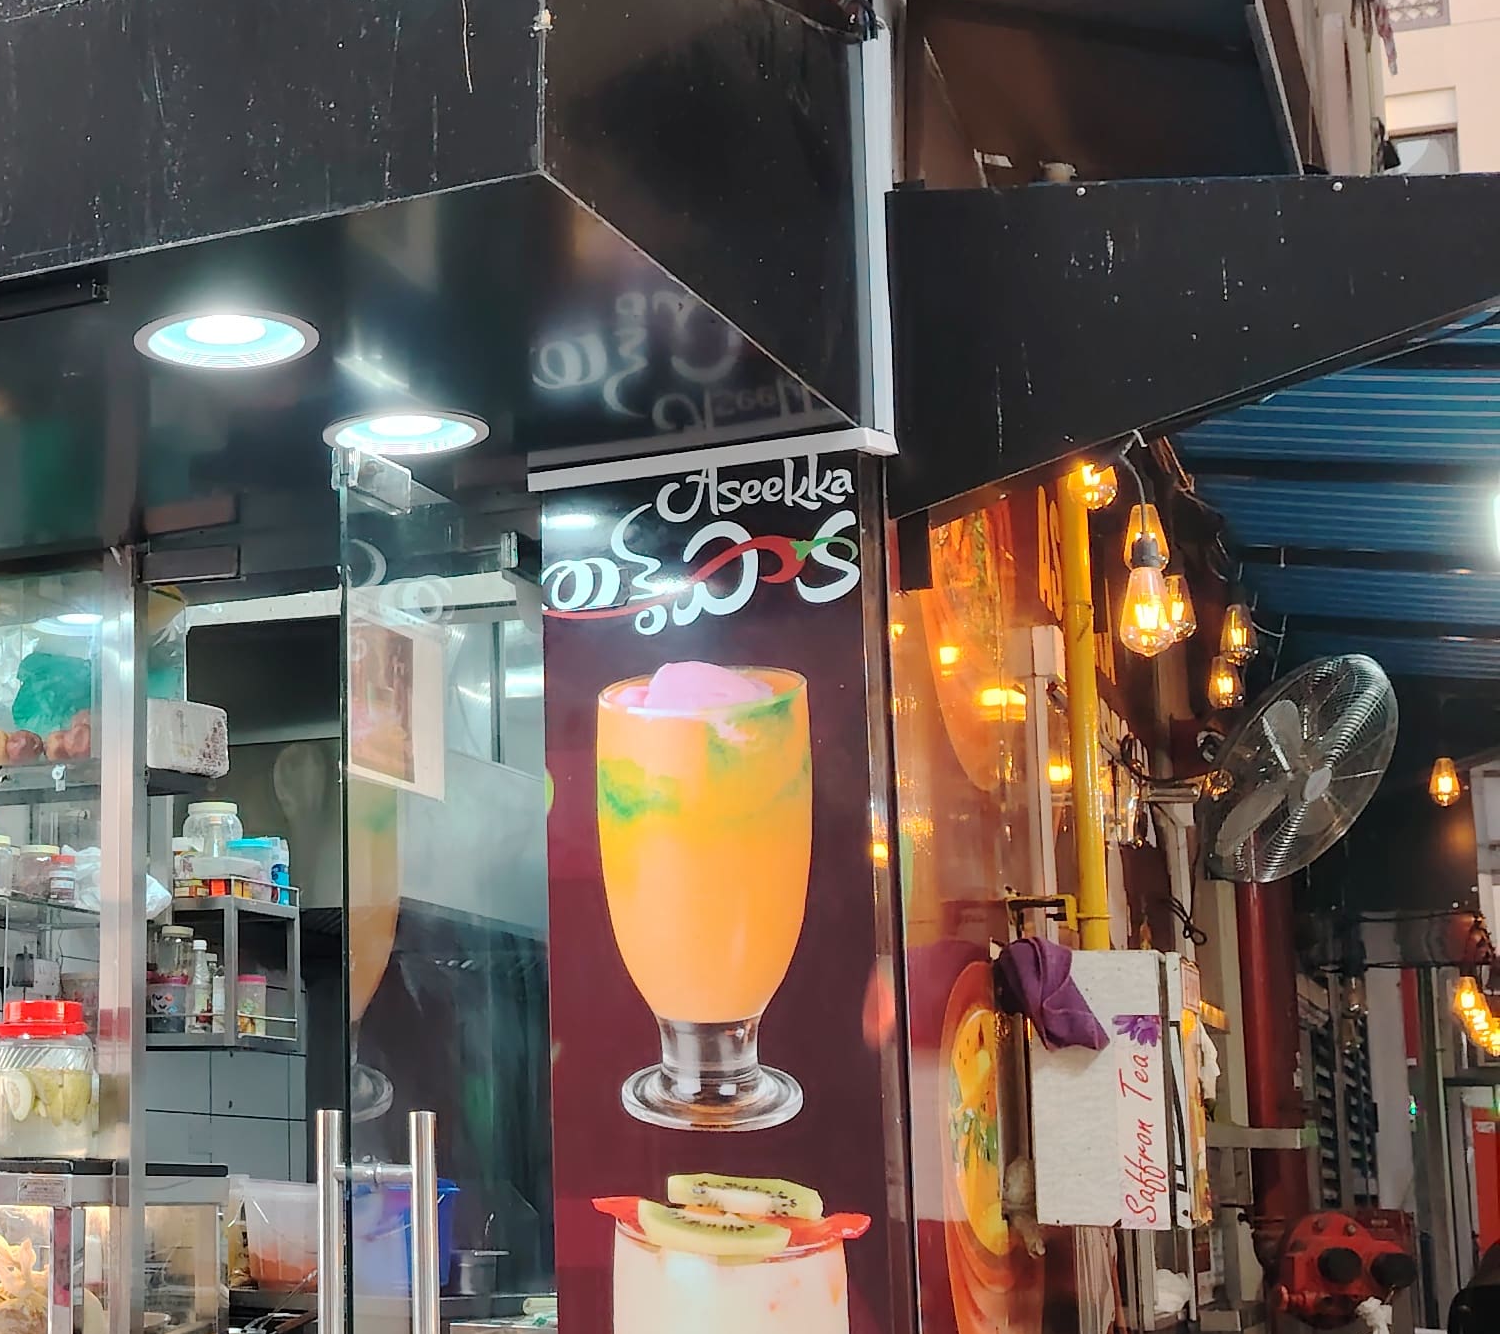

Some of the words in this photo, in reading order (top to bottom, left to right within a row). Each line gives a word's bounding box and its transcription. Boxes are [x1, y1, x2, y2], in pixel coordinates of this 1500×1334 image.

[655, 453, 854, 523] Aseekka
[1118, 1053, 1152, 1101] Tea
[1124, 1118, 1167, 1224] Saffron
